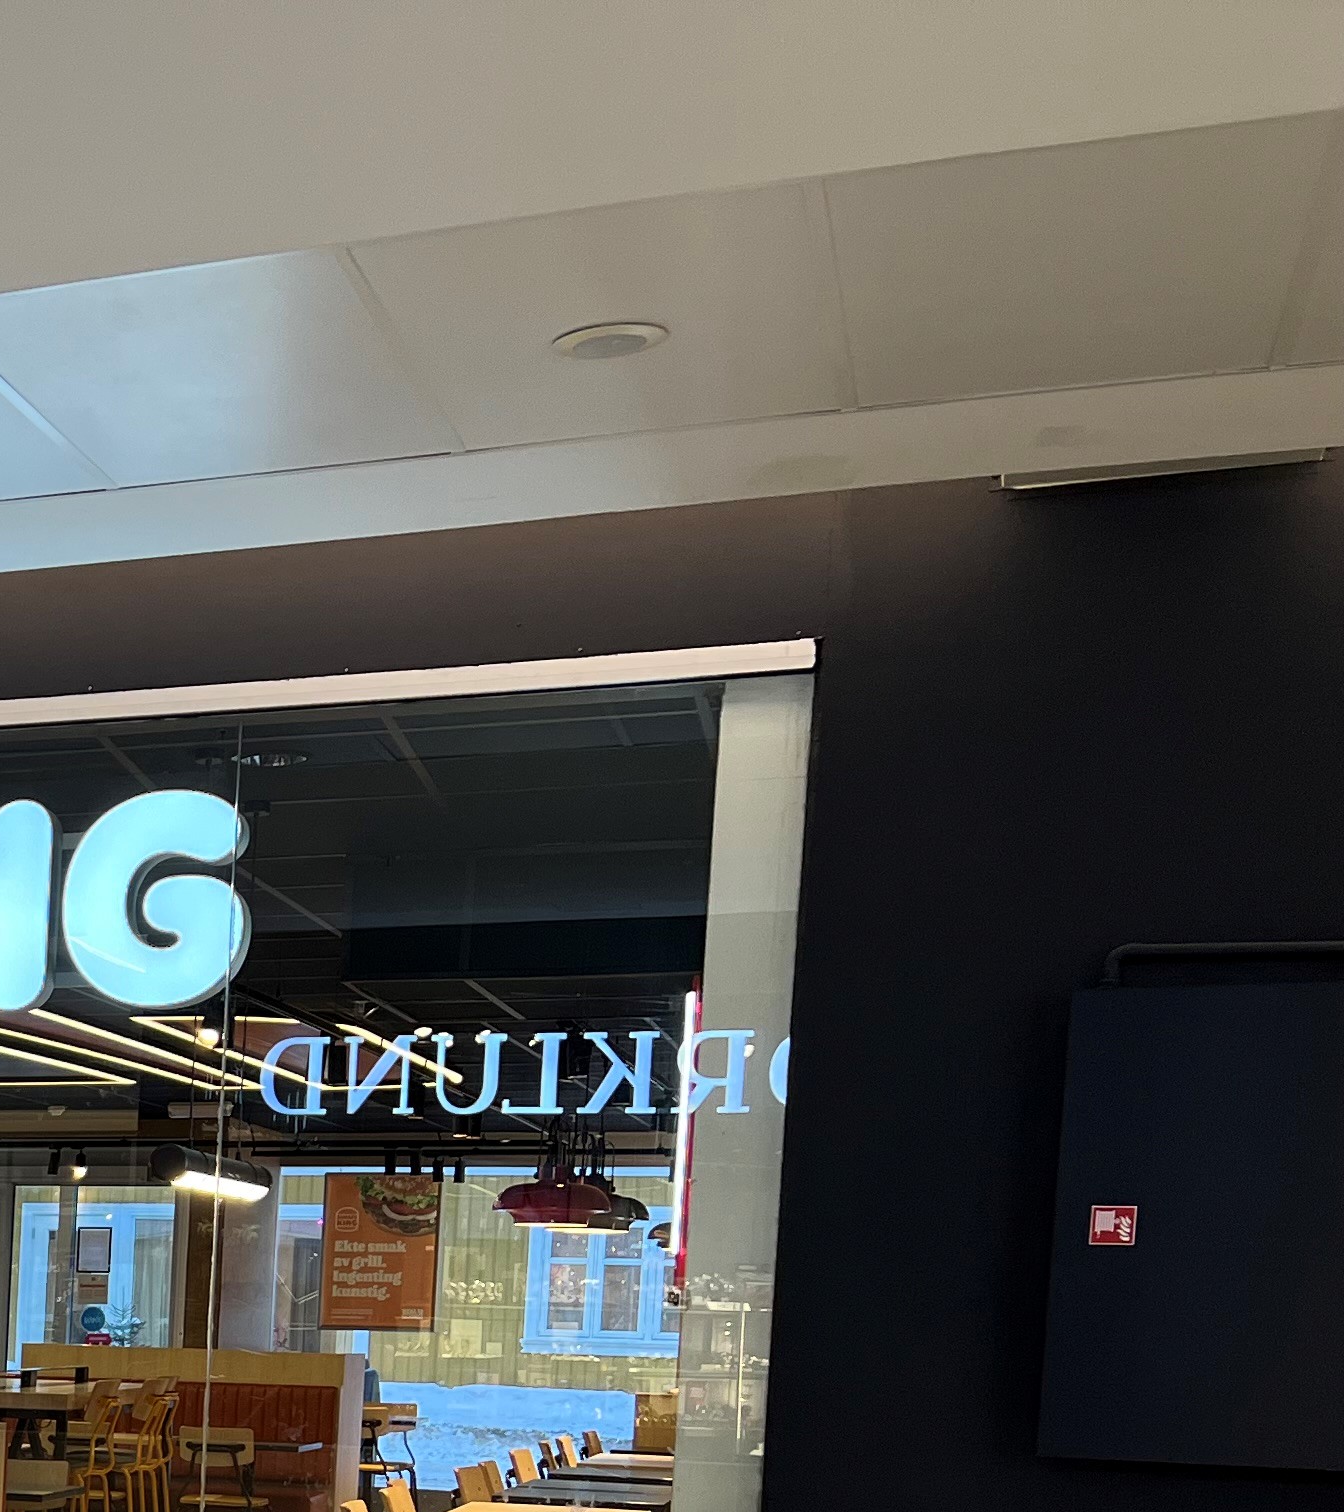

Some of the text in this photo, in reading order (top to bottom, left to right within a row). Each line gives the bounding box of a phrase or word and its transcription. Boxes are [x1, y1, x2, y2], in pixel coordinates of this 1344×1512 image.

[334, 1240, 407, 1253] Ekte smak
[334, 1255, 387, 1270] av grill.
[333, 1270, 402, 1286] Ingenting
[332, 1284, 390, 1301] kunstig.
